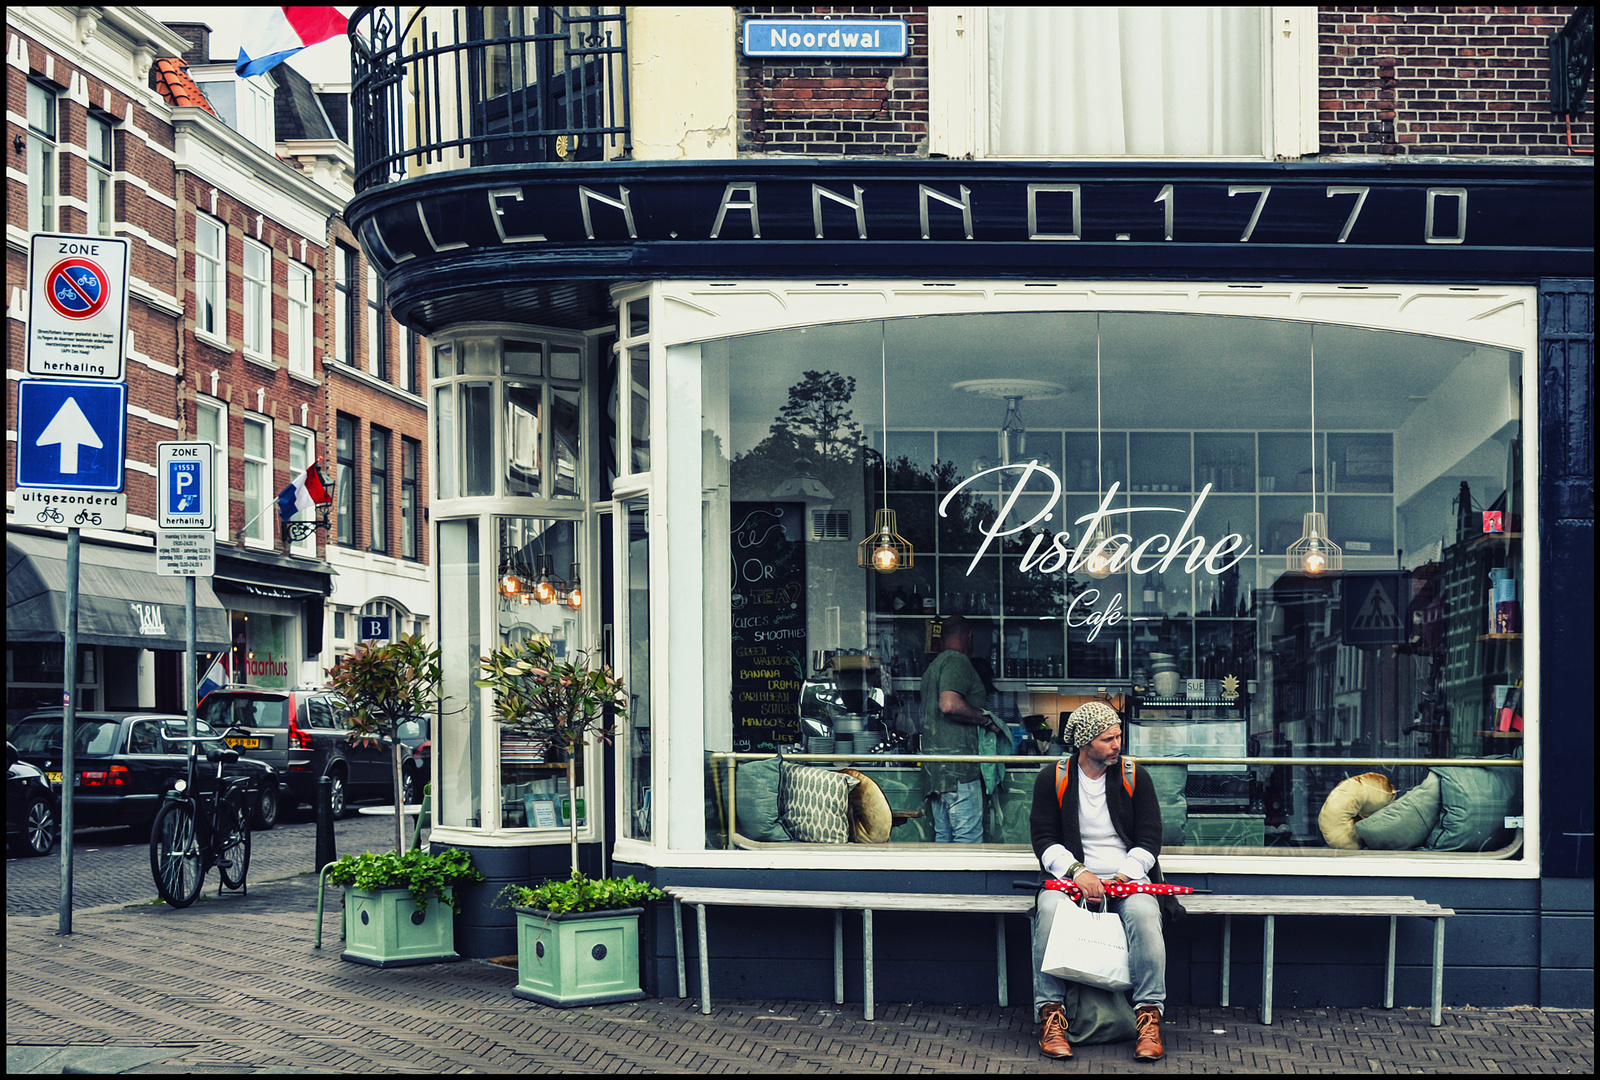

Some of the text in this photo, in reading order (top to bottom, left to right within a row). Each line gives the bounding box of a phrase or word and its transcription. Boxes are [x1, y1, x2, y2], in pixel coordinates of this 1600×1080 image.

[769, 26, 881, 49] Noordwal
[59, 243, 99, 256] ZONE
[44, 361, 104, 375] herhaling
[172, 448, 198, 457] ZONE
[177, 471, 194, 495] P
[22, 491, 118, 506] uitgezonderd
[166, 518, 205, 526] herhaling
[938, 459, 1253, 577] Pistache
[750, 581, 802, 610] TEA?
[1066, 588, 1123, 643] Café
[370, 621, 380, 637] B
[754, 628, 807, 642] SMOOTHIES
[244, 652, 288, 677] haarhuis
[740, 669, 781, 680] BANANA
[1187, 682, 1204, 691] SUE
[760, 703, 798, 715] SUNRIS
